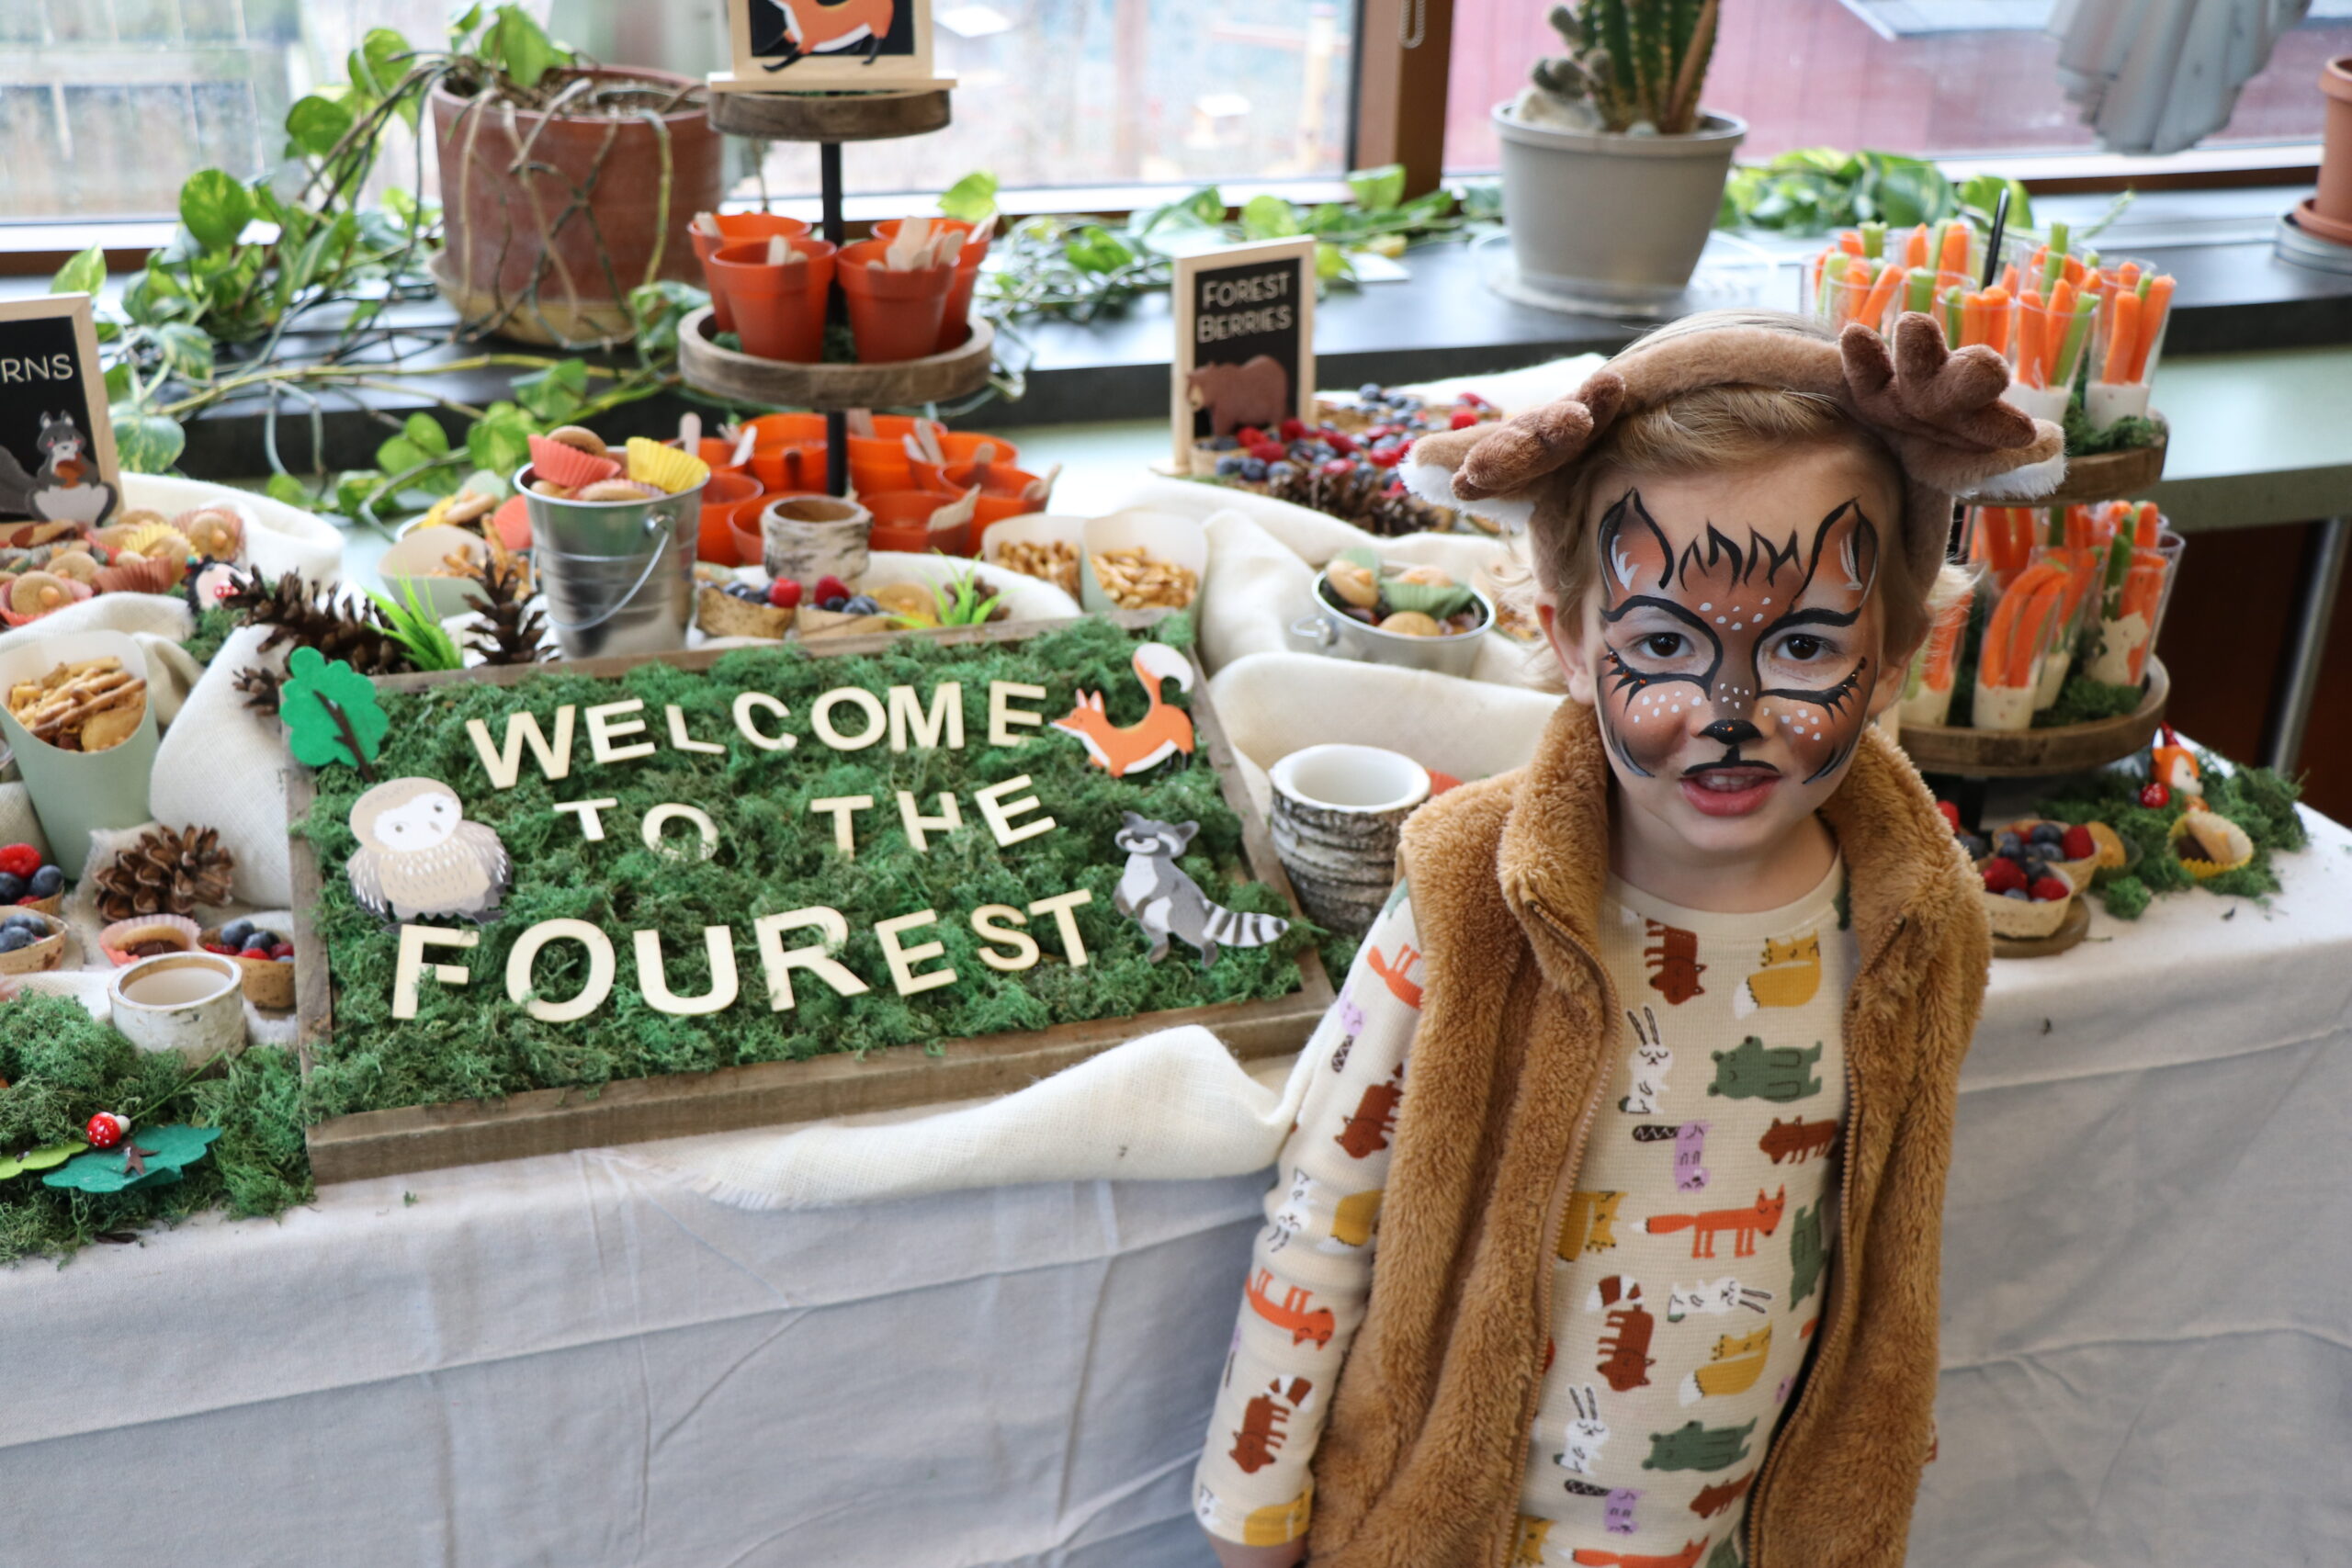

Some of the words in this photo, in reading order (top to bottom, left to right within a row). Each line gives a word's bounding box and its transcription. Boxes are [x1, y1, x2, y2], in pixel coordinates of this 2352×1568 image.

[1196, 304, 1293, 344] BERRIES
[1202, 271, 1291, 310] FOREST
[466, 680, 1046, 790] WELCOME
[552, 796, 719, 863] TO
[809, 773, 1057, 861] THE
[391, 888, 1093, 1023] FOUREST
